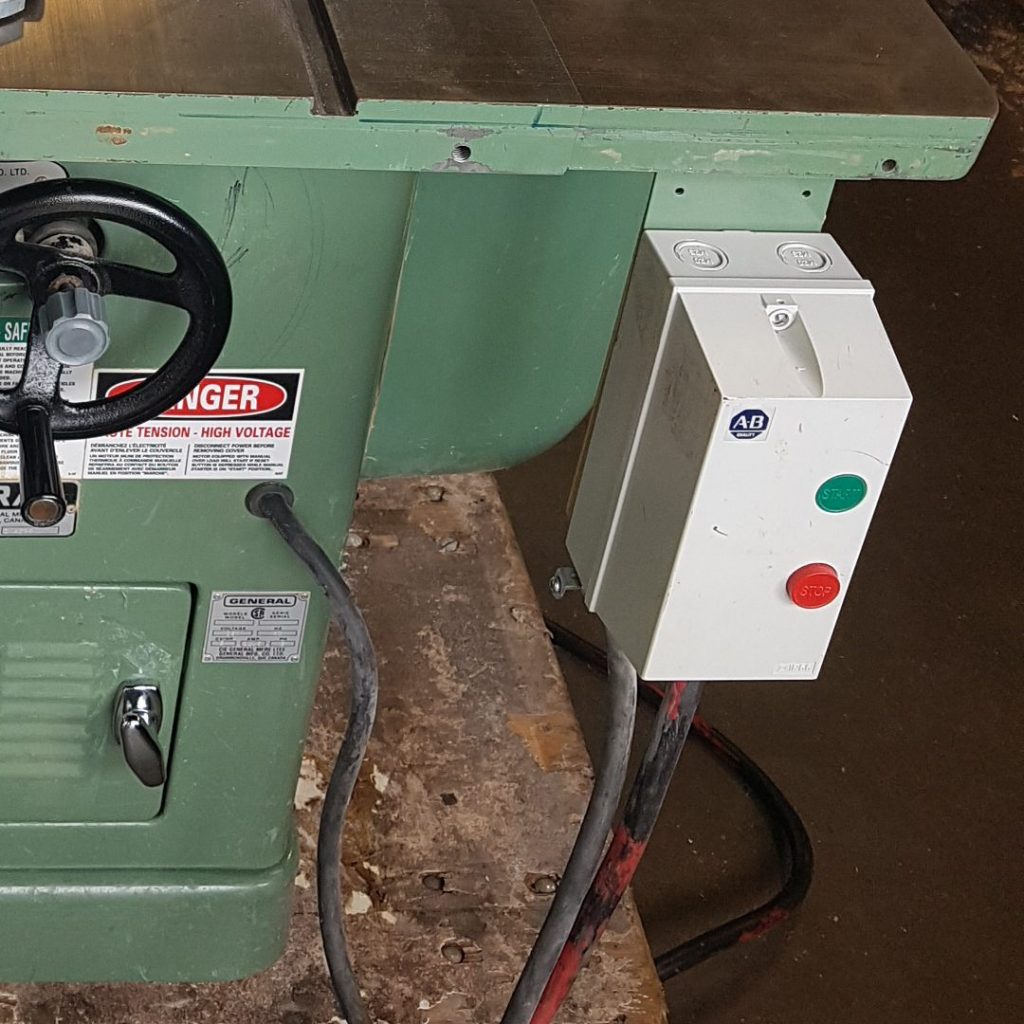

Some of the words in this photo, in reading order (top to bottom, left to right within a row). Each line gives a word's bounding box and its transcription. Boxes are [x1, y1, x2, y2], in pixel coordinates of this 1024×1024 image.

[10, 168, 30, 176] LTD.
[4, 321, 30, 341] SAF
[172, 384, 260, 411] NGER
[137, 427, 190, 438] TENSION
[201, 427, 231, 438] HIGH
[236, 427, 291, 438] VOLTAGE
[800, 585, 831, 597] STOP
